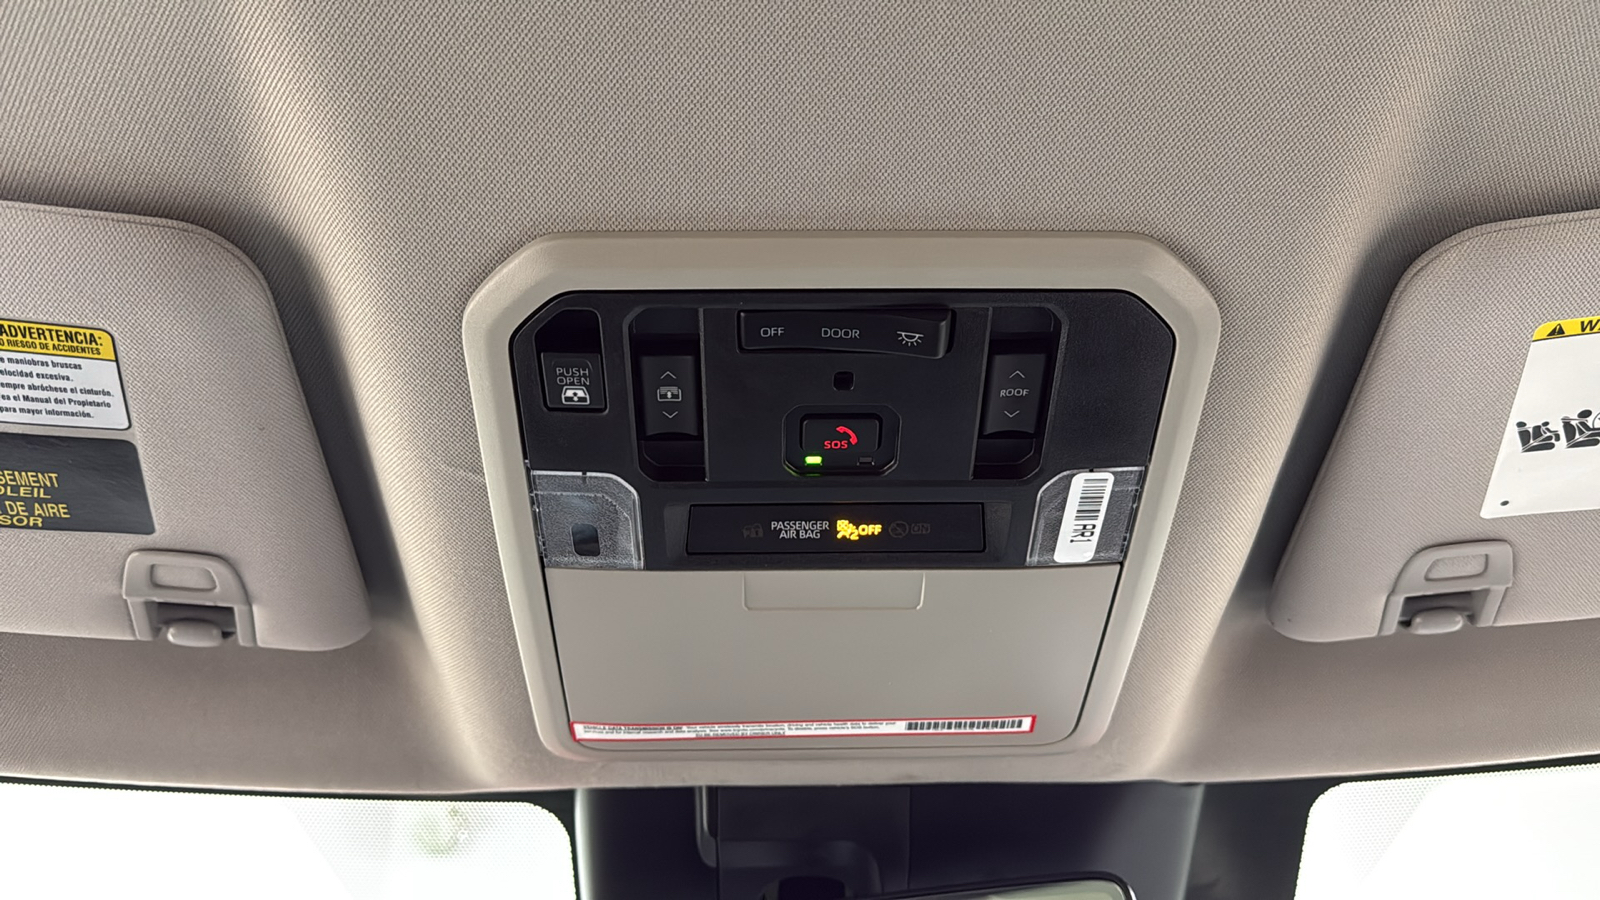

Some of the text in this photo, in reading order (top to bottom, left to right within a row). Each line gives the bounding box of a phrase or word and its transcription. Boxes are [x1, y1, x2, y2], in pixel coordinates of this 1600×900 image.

[1580, 318, 1600, 332] W
[0, 324, 103, 346] ADVERTENCIA:
[760, 327, 860, 339] OFF DOOR
[7, 339, 37, 349] RIESGO
[39, 343, 51, 351] DE
[52, 344, 101, 355] ACCIDENTES
[7, 357, 49, 368] maniobras
[51, 360, 82, 370] bruscas
[36, 373, 74, 382] excesiva.
[556, 367, 589, 377] PUSH
[556, 376, 590, 386] OPEN
[70, 386, 78, 394] el
[1000, 388, 1030, 398] ROOF
[12, 394, 21, 402] el
[22, 394, 52, 404] Manual
[53, 396, 67, 405] del
[68, 398, 112, 409] Propietario
[0, 406, 17, 414] para
[18, 407, 43, 417] mayor
[824, 440, 848, 449] SOS
[5, 501, 71, 518] DE AIRE
[771, 520, 830, 531] PASSENGER
[858, 524, 882, 536] OFF
[779, 530, 821, 539] AIR BAG
[1069, 523, 1097, 544] AR1
